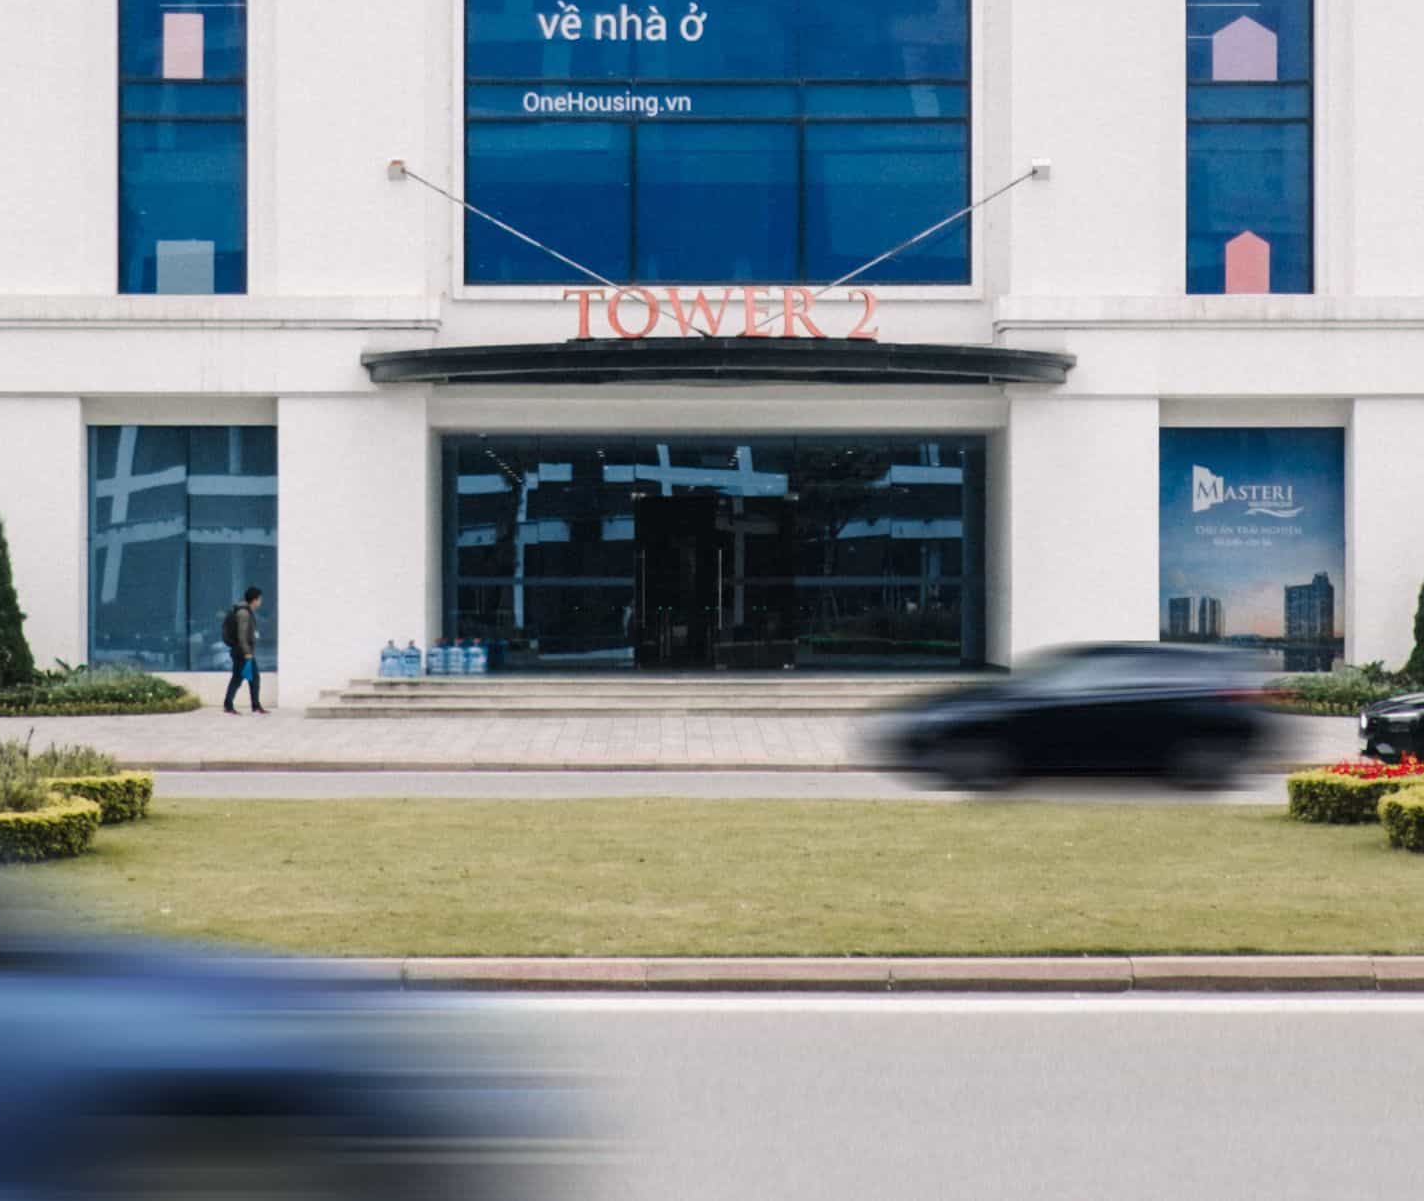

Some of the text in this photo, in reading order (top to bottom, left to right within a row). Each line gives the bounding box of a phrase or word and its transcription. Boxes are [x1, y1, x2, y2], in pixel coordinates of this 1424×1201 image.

[538, 0, 708, 41] về nhà ở
[523, 91, 691, 117] OneHousing.vn
[564, 287, 880, 339] TOWER 2
[1197, 480, 1293, 500] MASTERI
